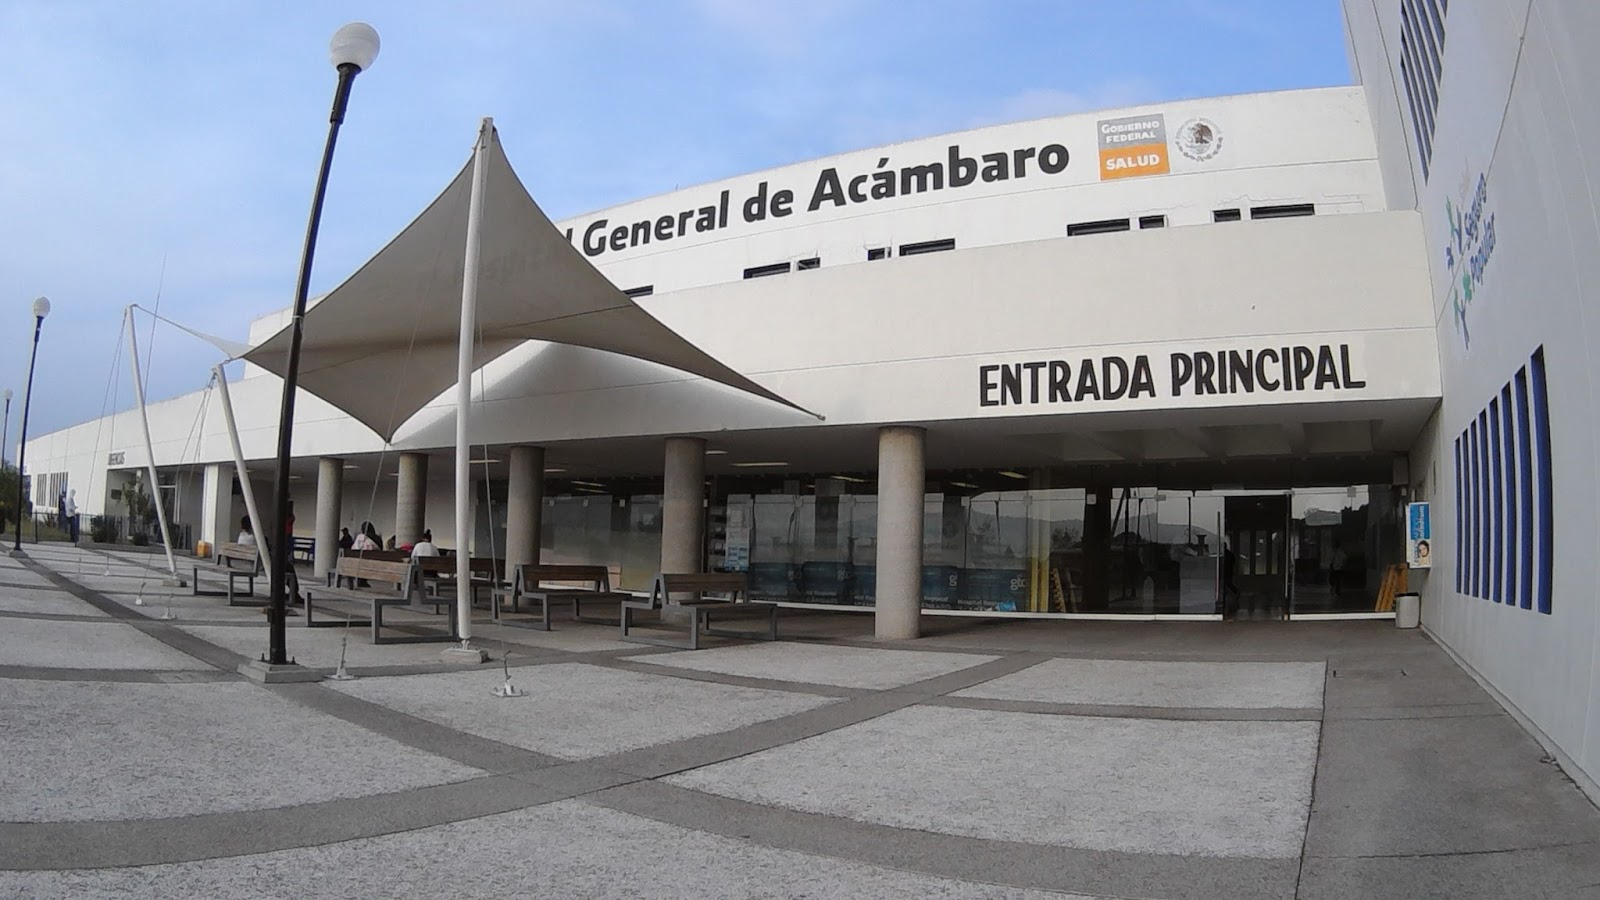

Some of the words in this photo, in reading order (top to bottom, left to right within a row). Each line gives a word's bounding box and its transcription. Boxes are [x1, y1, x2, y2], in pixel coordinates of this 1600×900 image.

[1101, 120, 1160, 134] GOBIERNO
[1106, 131, 1156, 143] FEDERAL
[1106, 154, 1160, 171] SALUD
[583, 190, 729, 256] General
[743, 181, 793, 223] de
[807, 145, 1070, 212] Acámbaro
[980, 355, 1156, 407] ENTRADA
[1170, 344, 1366, 397] PRINCIPAL
